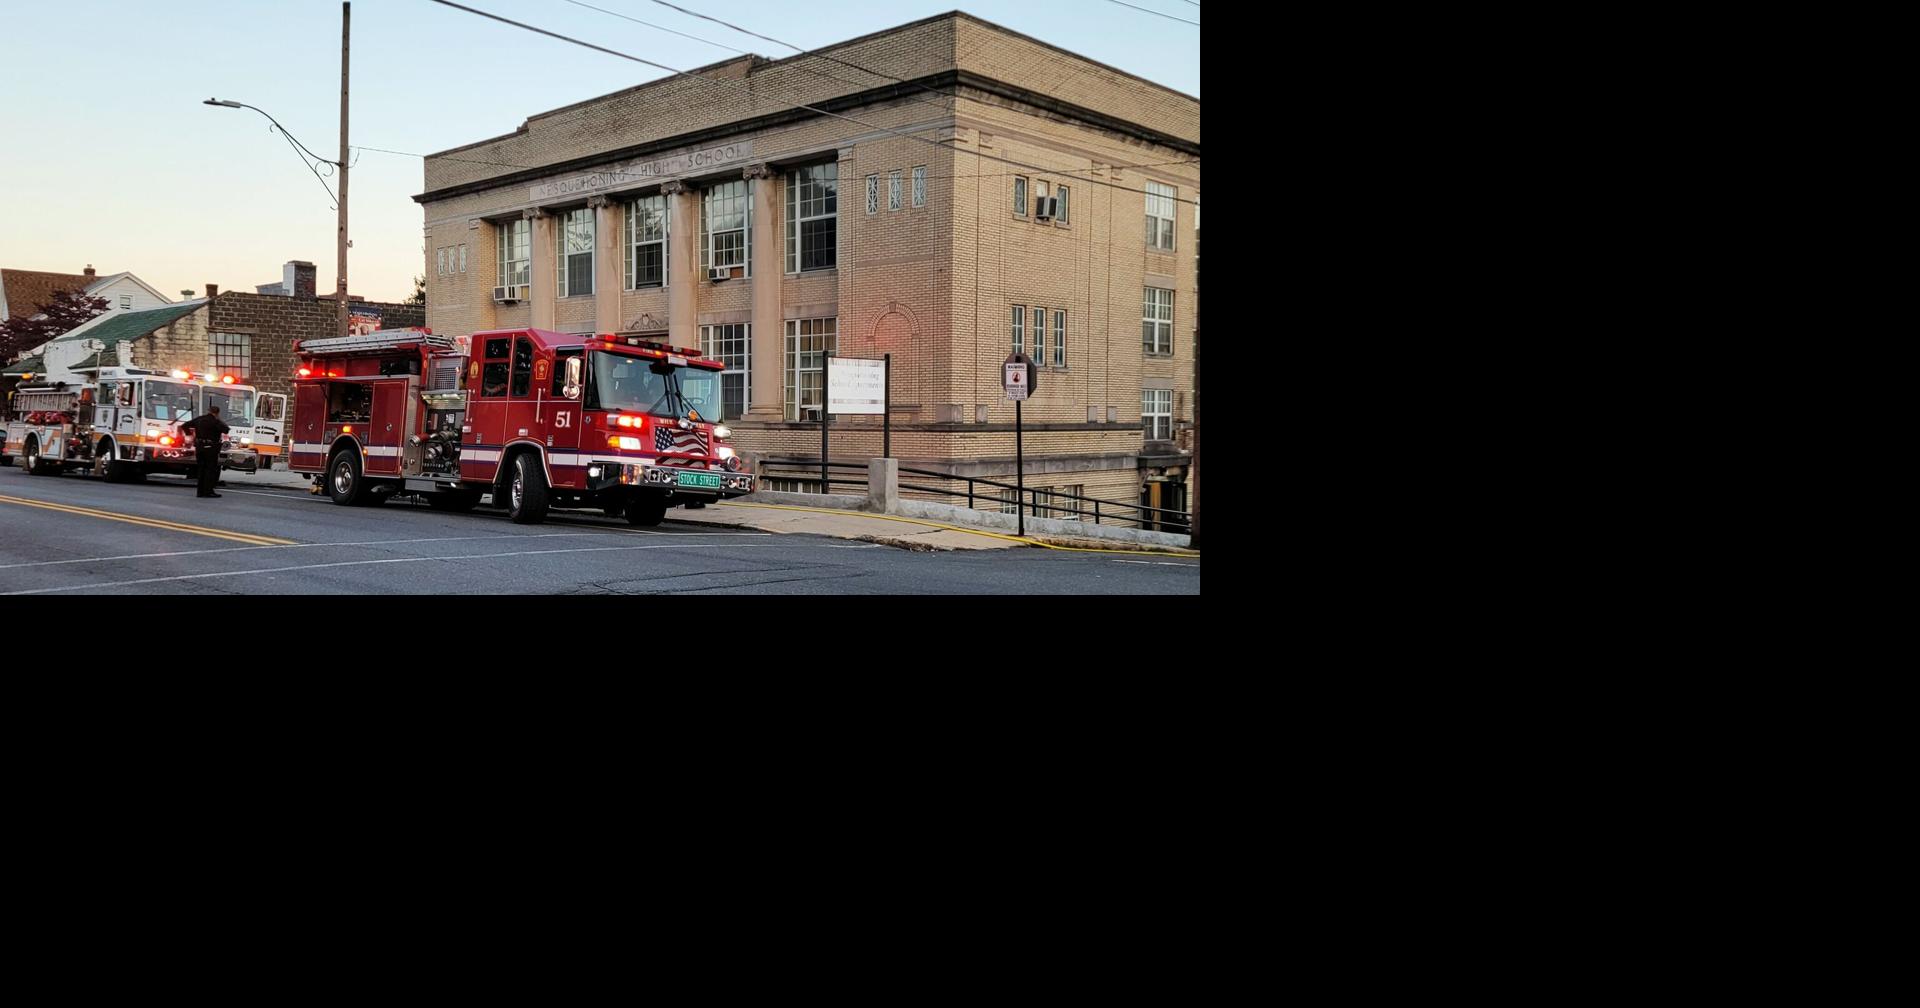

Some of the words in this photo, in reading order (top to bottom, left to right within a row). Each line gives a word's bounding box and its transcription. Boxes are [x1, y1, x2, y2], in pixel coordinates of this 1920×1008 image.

[540, 168, 625, 197] NESQUEHONING
[640, 159, 670, 177] HIGH
[687, 143, 744, 168] SCHOOL
[555, 411, 571, 428] 51
[680, 473, 698, 485] STOCK
[700, 475, 719, 487] STREET
